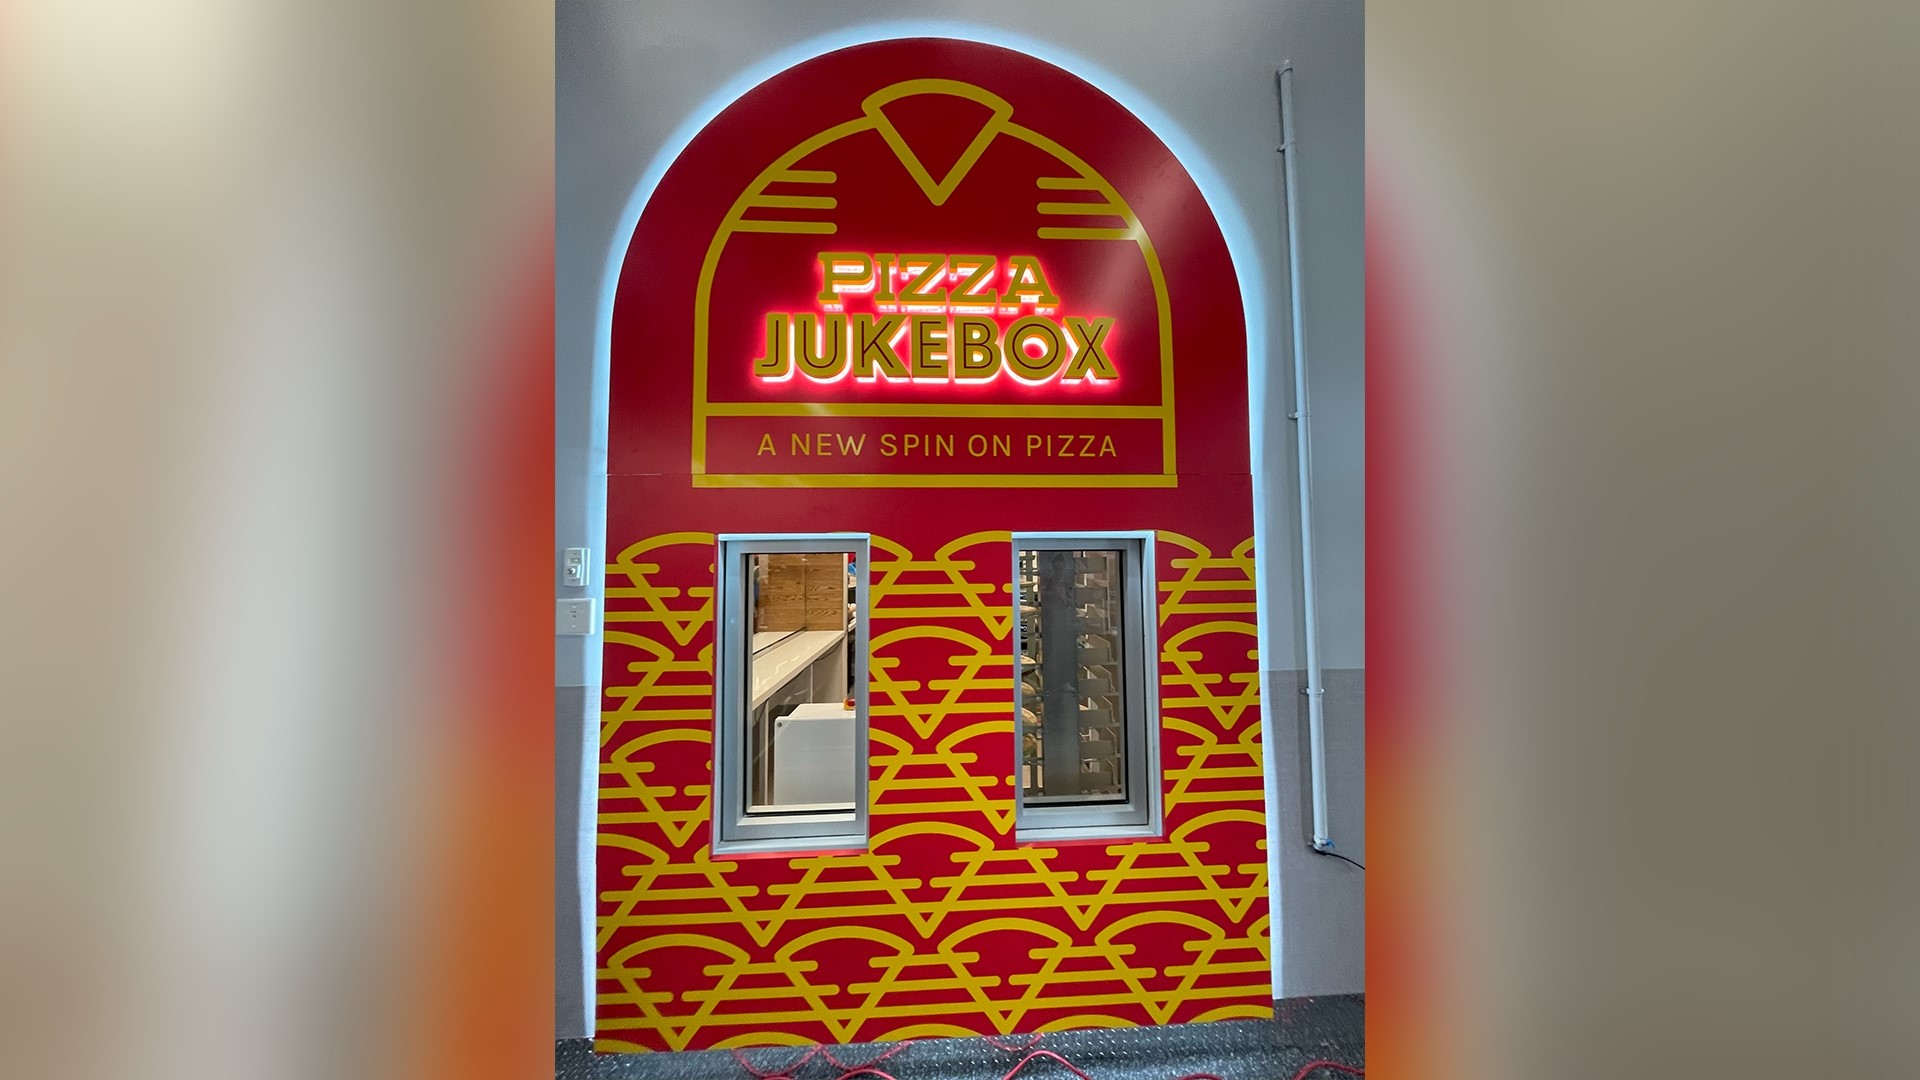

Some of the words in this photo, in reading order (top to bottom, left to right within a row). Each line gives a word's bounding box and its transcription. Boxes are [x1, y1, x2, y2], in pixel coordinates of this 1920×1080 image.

[817, 251, 1060, 308] PIZZA
[754, 312, 1119, 380] JUKEBOX
[757, 433, 777, 456] A
[791, 433, 867, 456] NEW
[880, 433, 954, 457] SPIN
[967, 434, 1012, 457] ON
[1026, 434, 1118, 457] PIZZA
